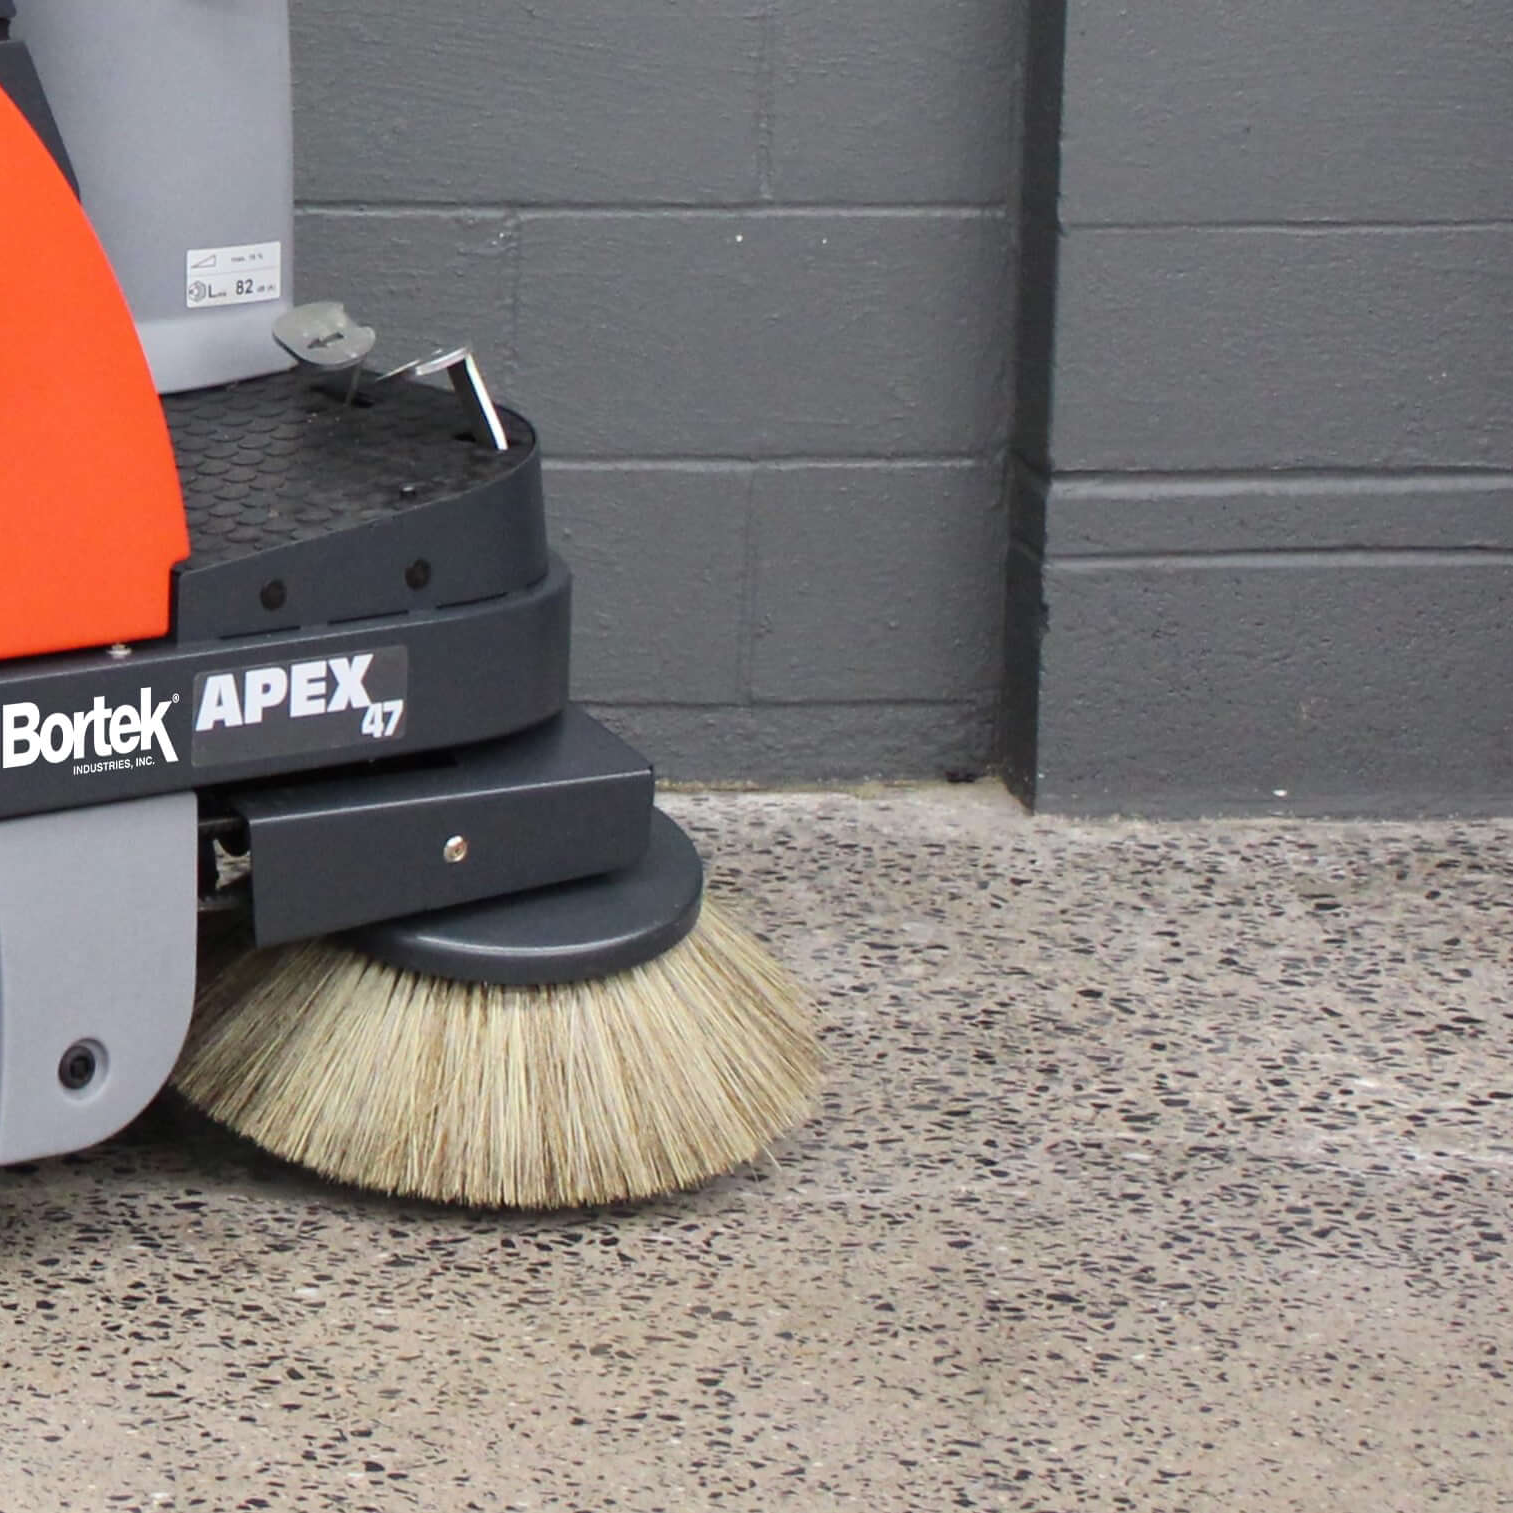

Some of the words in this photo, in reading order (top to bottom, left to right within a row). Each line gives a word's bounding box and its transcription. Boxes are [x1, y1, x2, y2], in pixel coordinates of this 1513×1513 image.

[235, 279, 254, 295] 82
[195, 653, 374, 731] APEX
[361, 700, 404, 738] 47
[73, 759, 134, 776] INDUSTRIES,
[135, 756, 155, 767] INC.
